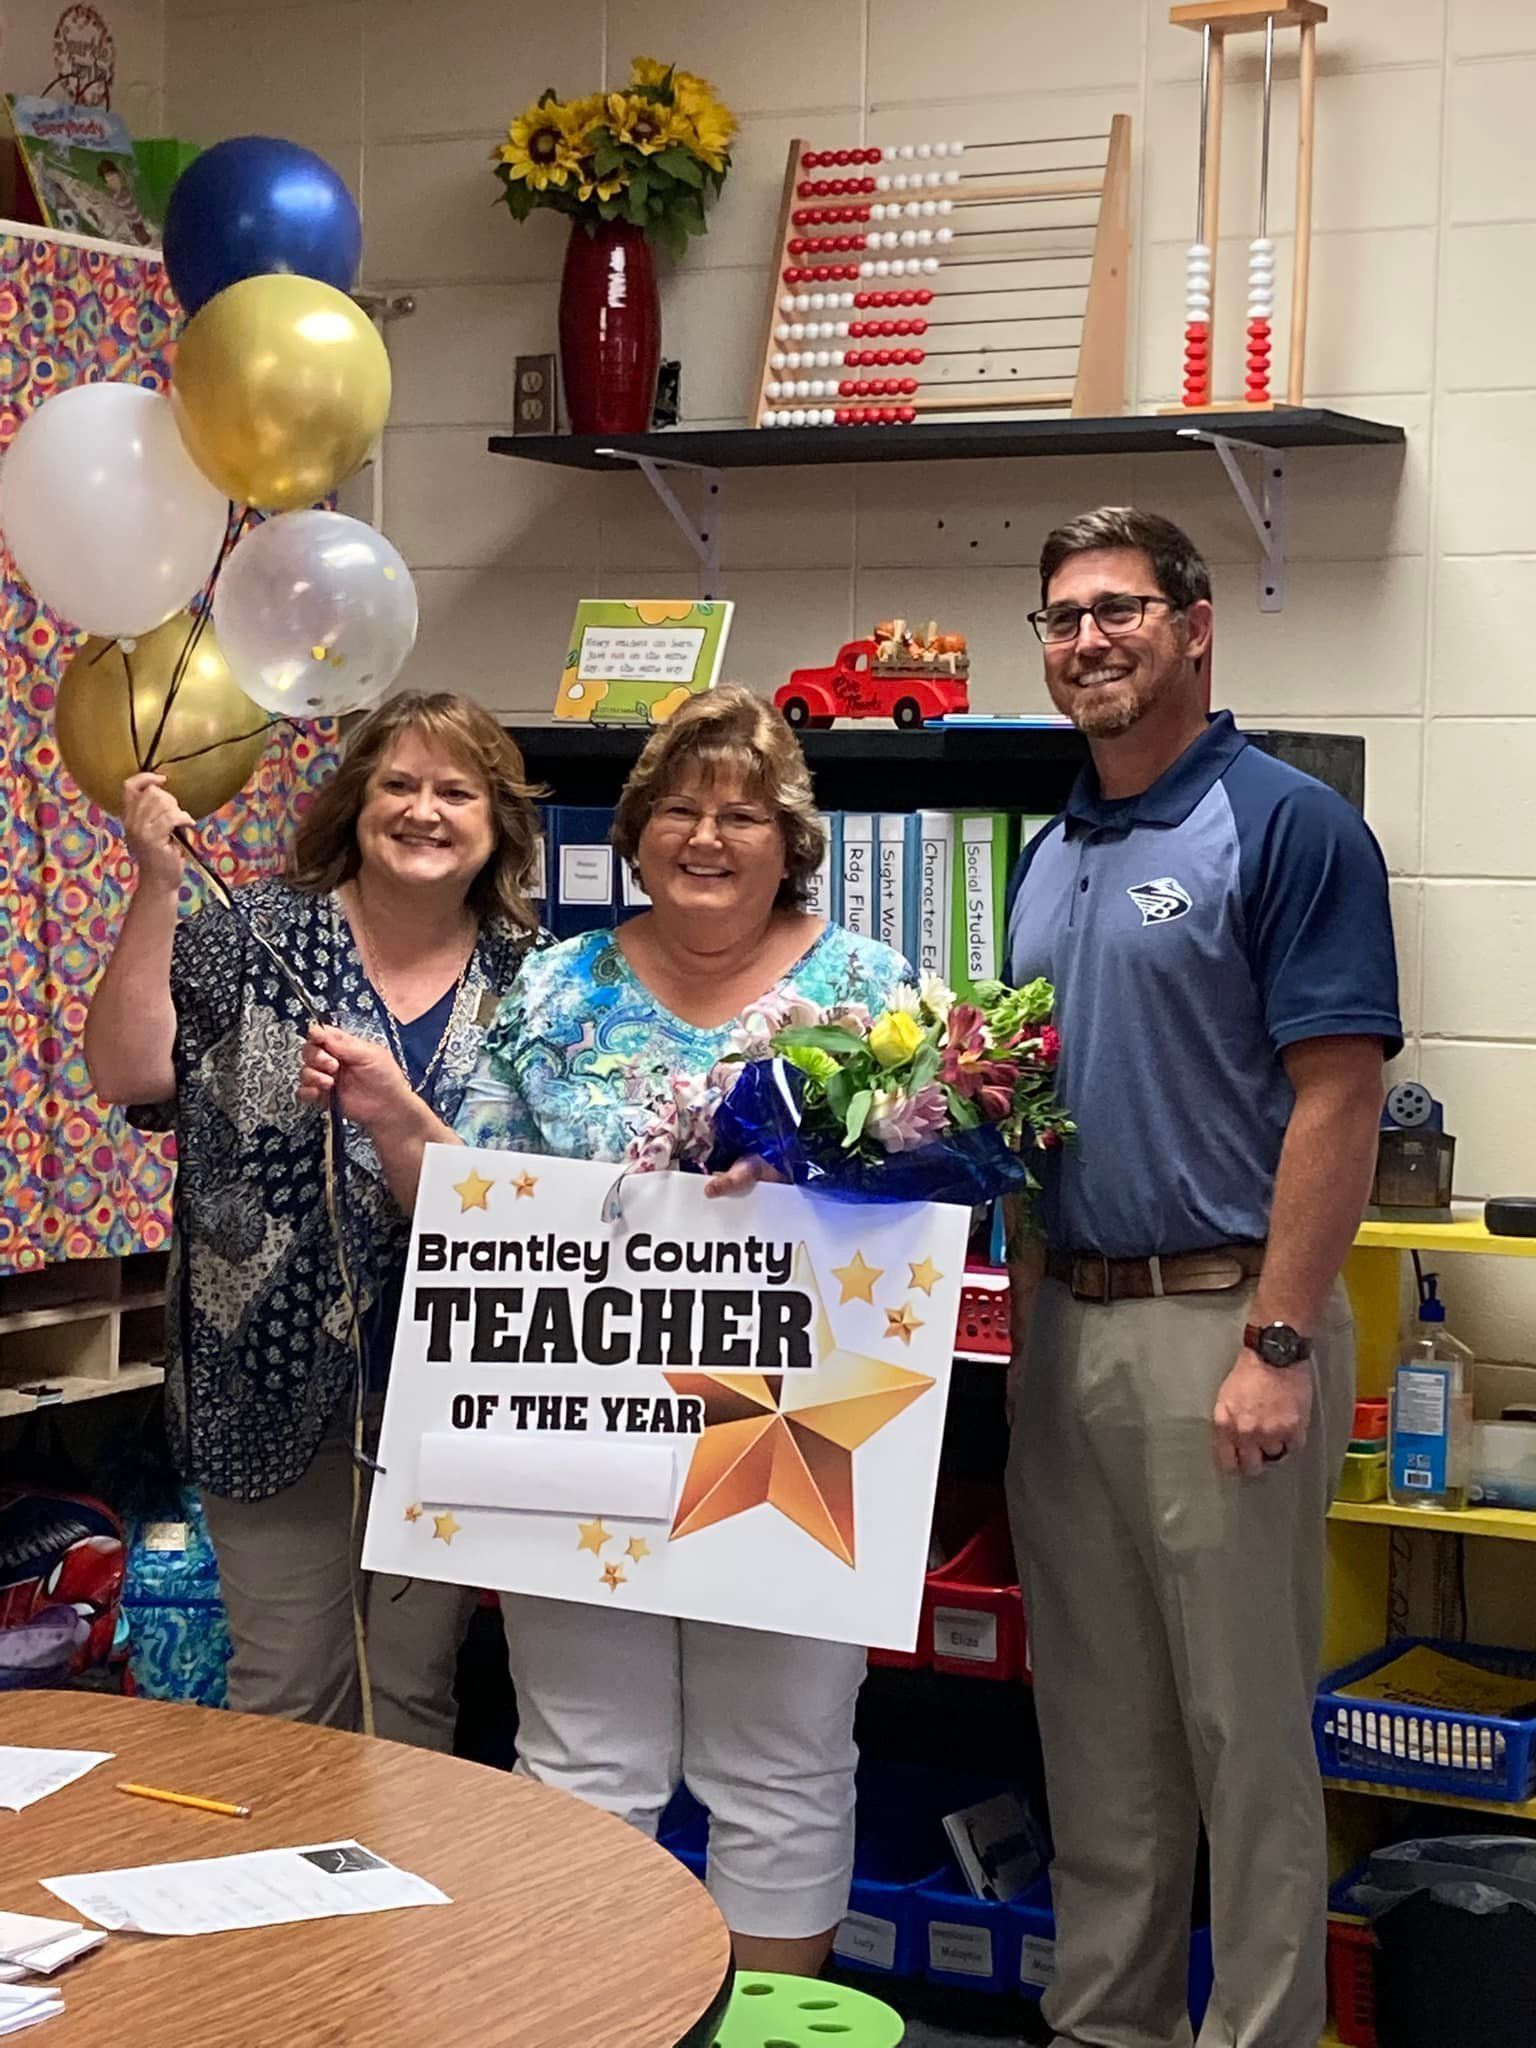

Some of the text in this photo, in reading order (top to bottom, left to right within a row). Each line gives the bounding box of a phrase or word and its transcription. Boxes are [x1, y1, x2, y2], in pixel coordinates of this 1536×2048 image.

[845, 848, 864, 883] Rdg
[880, 850, 896, 899] Sight
[921, 842, 939, 969] Character Ed
[967, 845, 988, 972] Social Studies
[416, 1233, 793, 1284] Brantley County
[414, 1287, 813, 1368] TEACHER
[452, 1394, 702, 1433] OF THE YEAR
